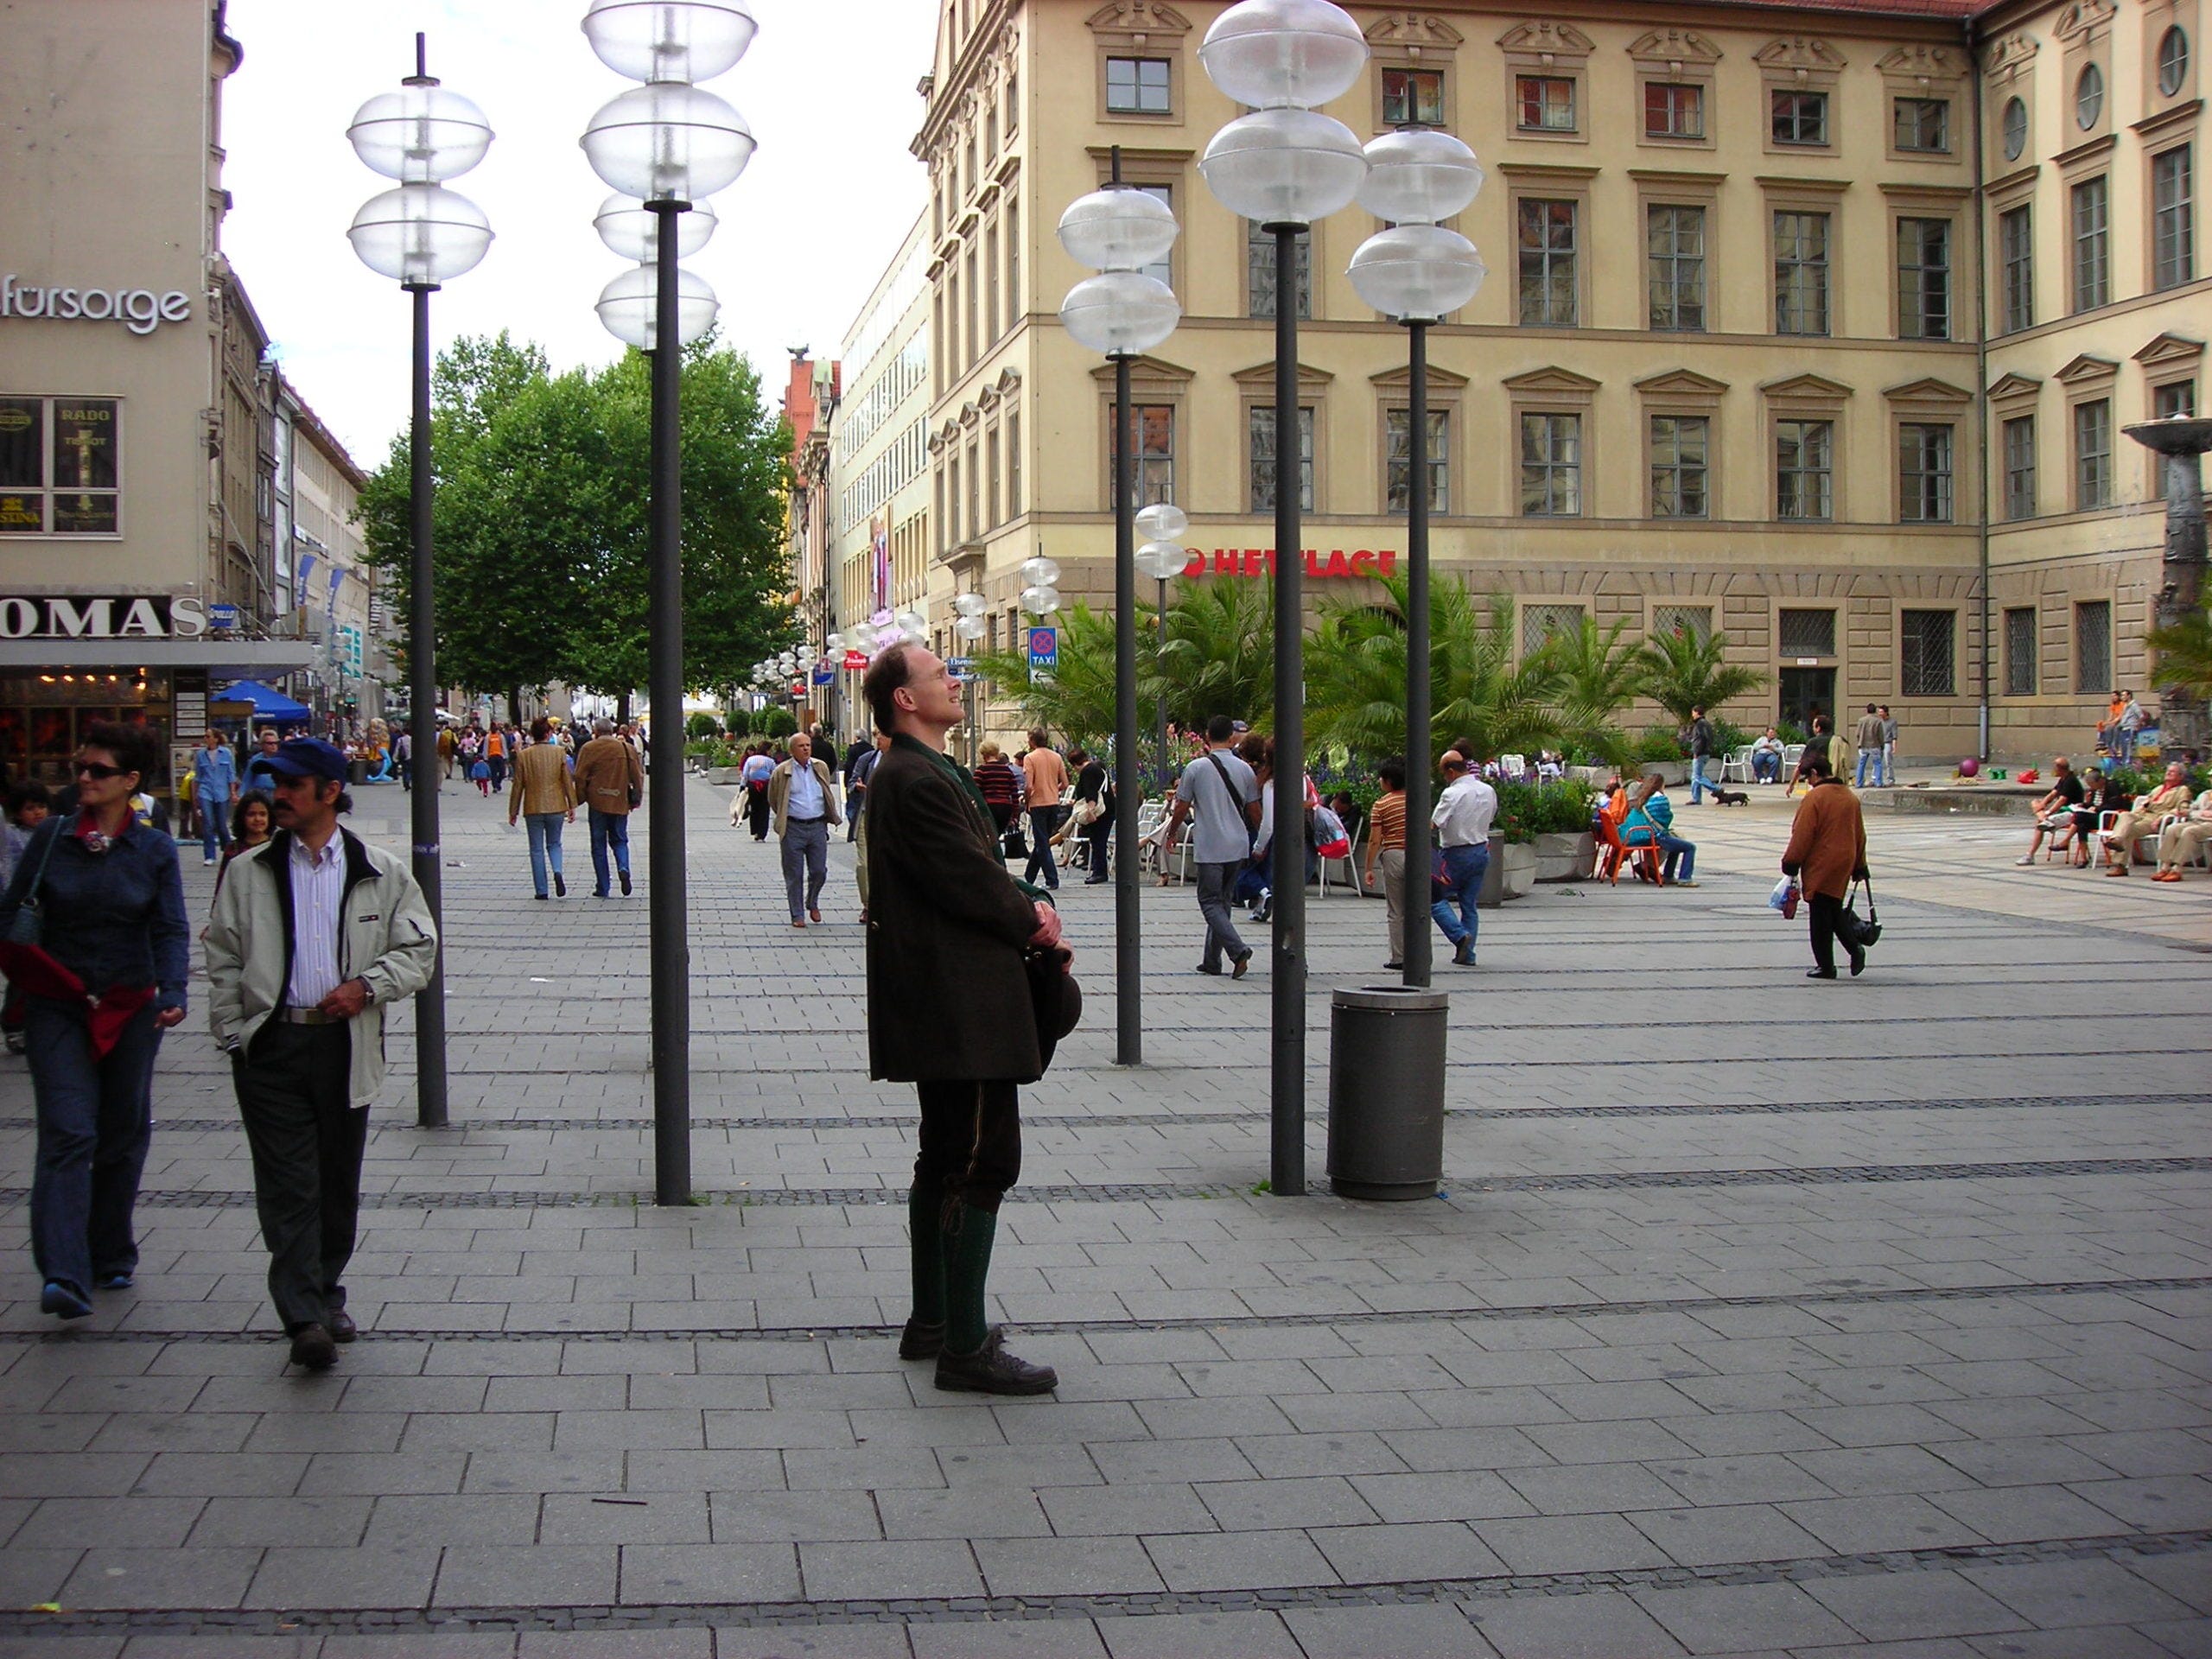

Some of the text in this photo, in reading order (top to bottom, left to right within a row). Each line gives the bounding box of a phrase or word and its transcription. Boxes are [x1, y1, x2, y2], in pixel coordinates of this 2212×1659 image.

[2, 274, 190, 334] fürsorge
[61, 410, 110, 421] RADO
[64, 437, 106, 446] TISOT
[1214, 549, 1396, 577] HETLAGE
[0, 597, 207, 638] OMAS
[1033, 656, 1055, 665] TAXI
